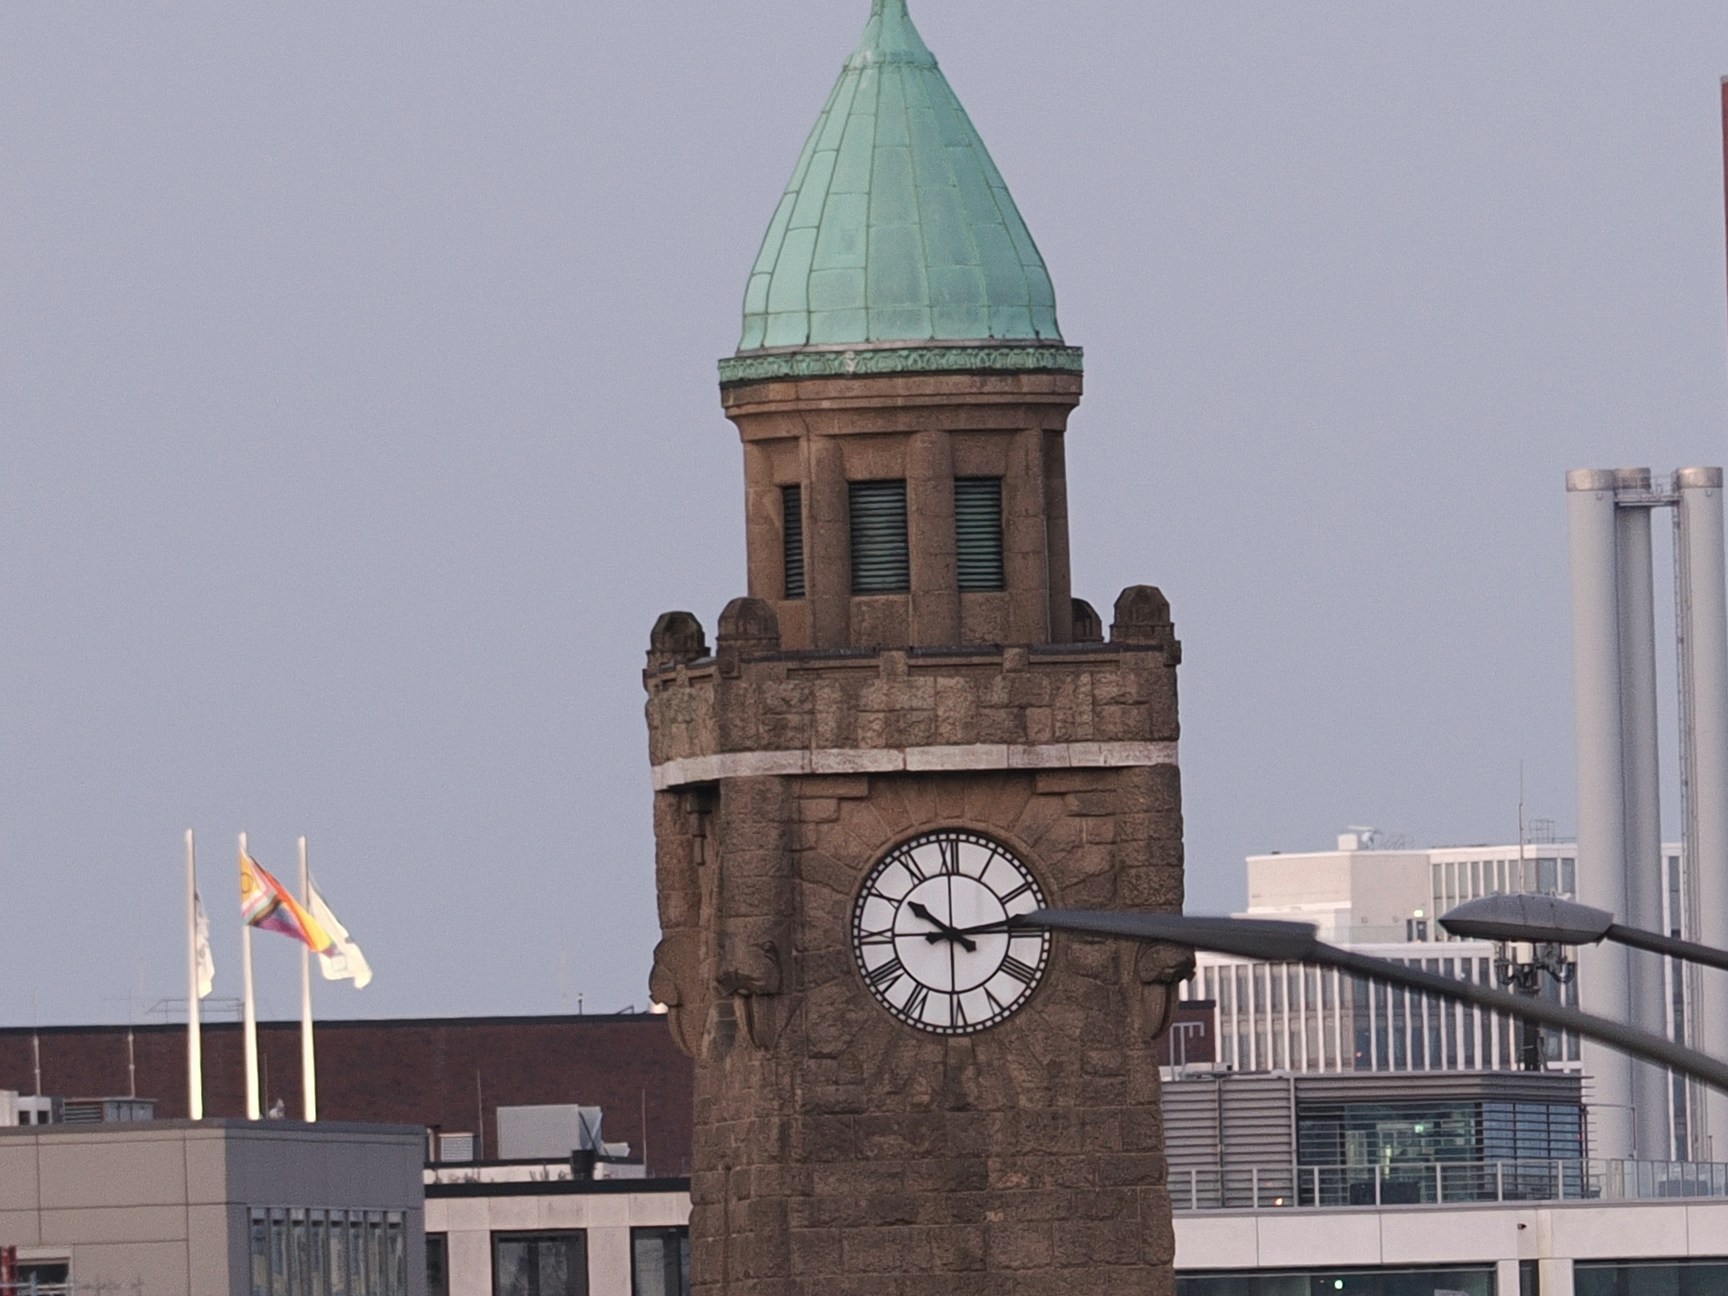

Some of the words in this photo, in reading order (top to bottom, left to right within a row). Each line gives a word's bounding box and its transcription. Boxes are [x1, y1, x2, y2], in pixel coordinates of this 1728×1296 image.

[896, 852, 927, 886] XI
[938, 841, 960, 875] XII
[978, 851, 996, 881] I
[867, 886, 901, 910] X
[1000, 882, 1031, 905] II
[860, 927, 894, 946] IX
[868, 957, 906, 995] VIII
[999, 955, 1036, 985] IIII
[901, 984, 930, 1021] VII
[950, 993, 969, 1027] VI
[983, 985, 1005, 1015] V
